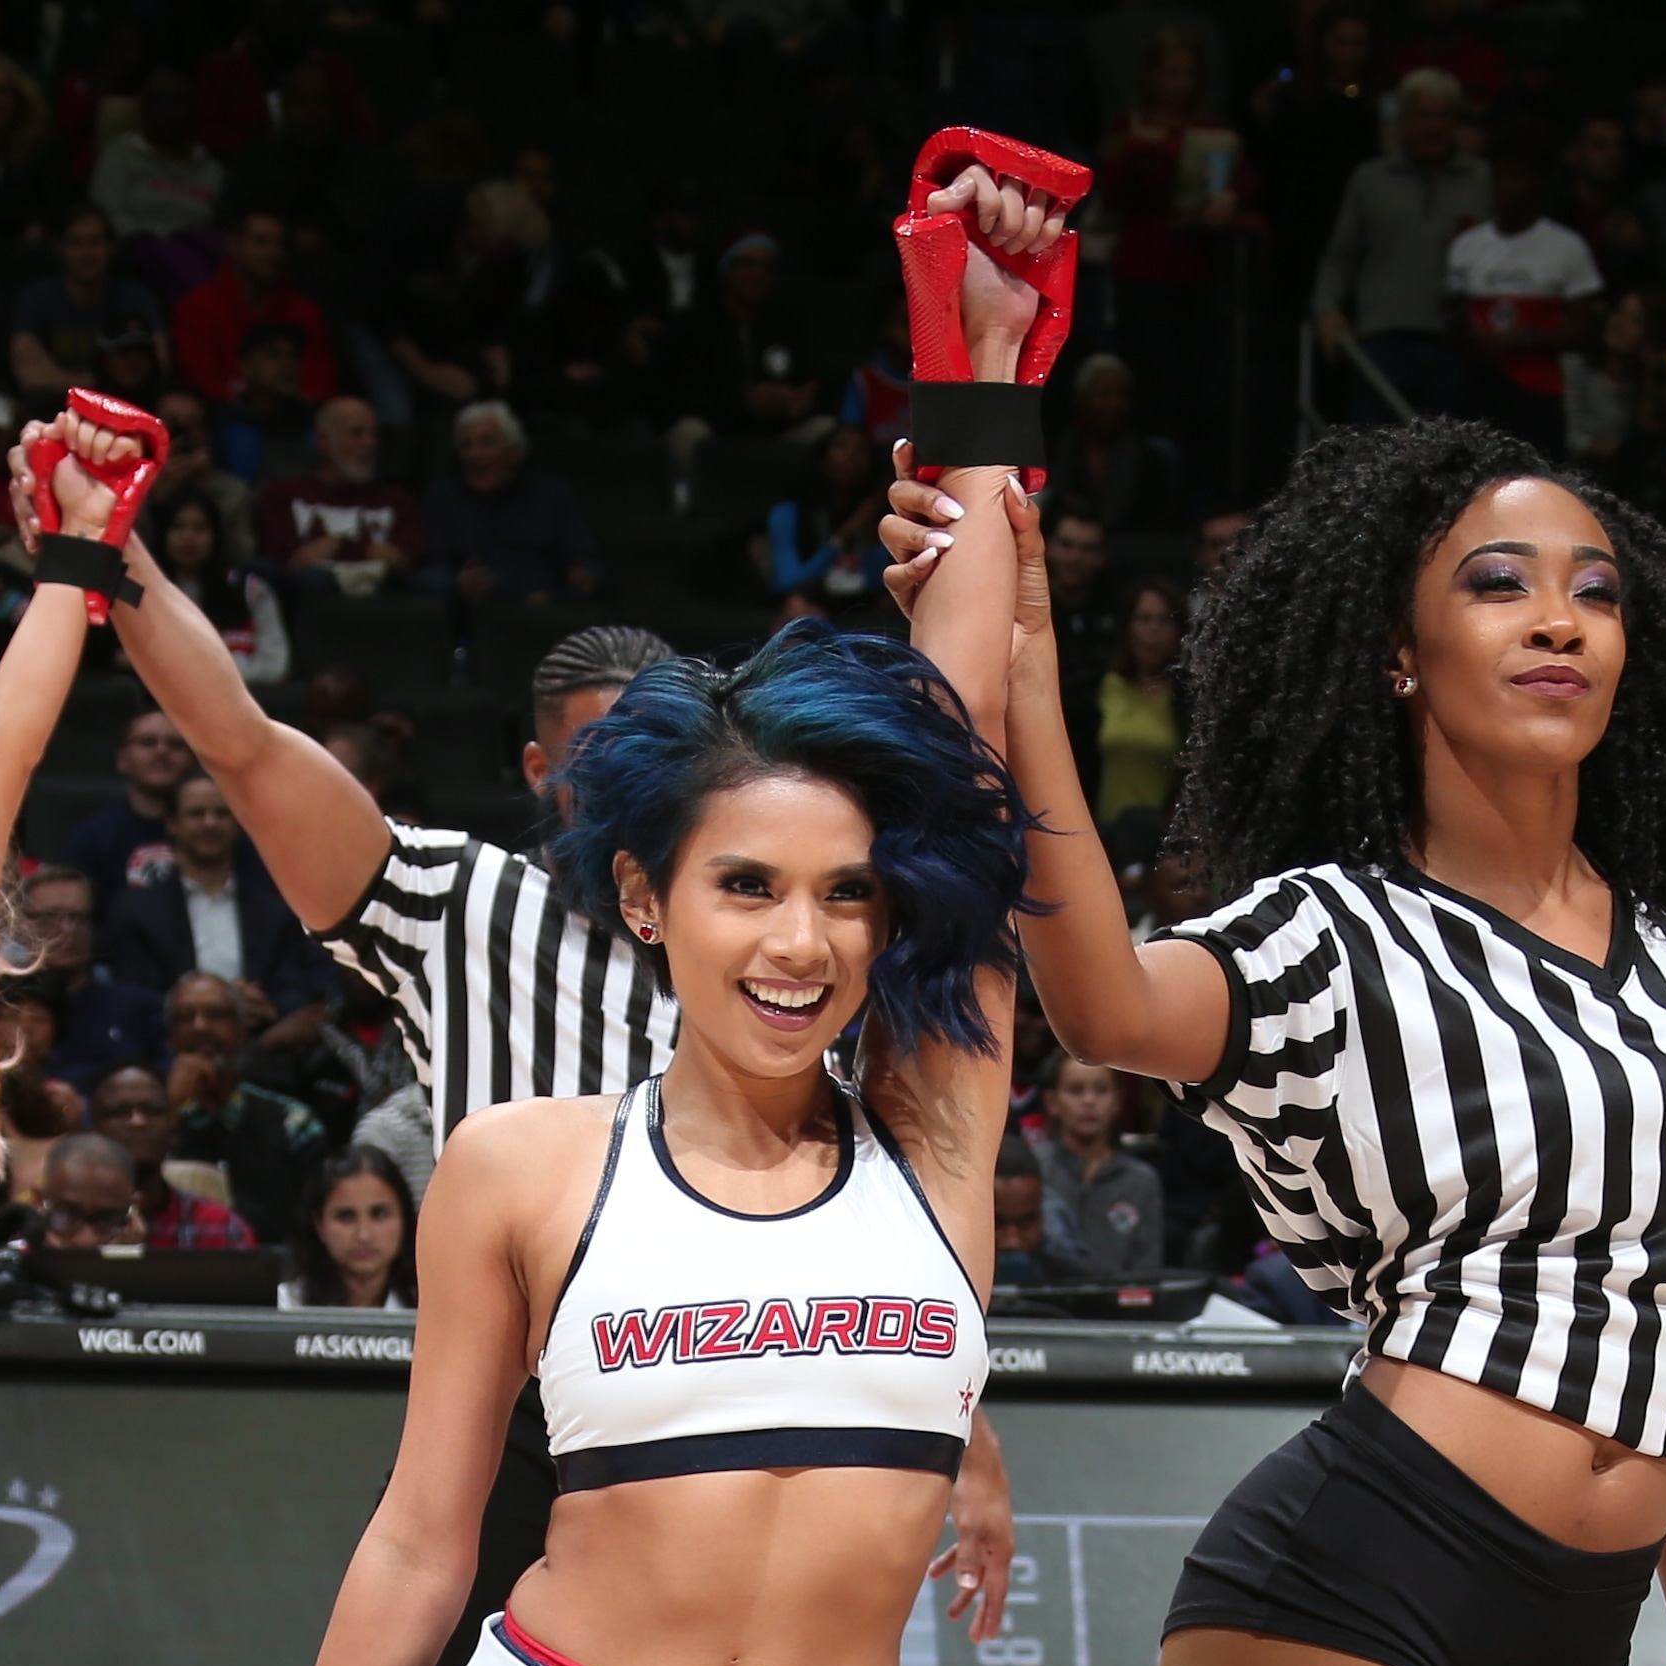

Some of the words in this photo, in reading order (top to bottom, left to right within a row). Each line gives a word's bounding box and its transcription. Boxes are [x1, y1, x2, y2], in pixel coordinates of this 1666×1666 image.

[78, 1328, 205, 1354] WGL.COM
[295, 1334, 413, 1361] #ASKWGL
[592, 1296, 957, 1373] WIZARDS
[1132, 1352, 1252, 1376] #ASKWGL
